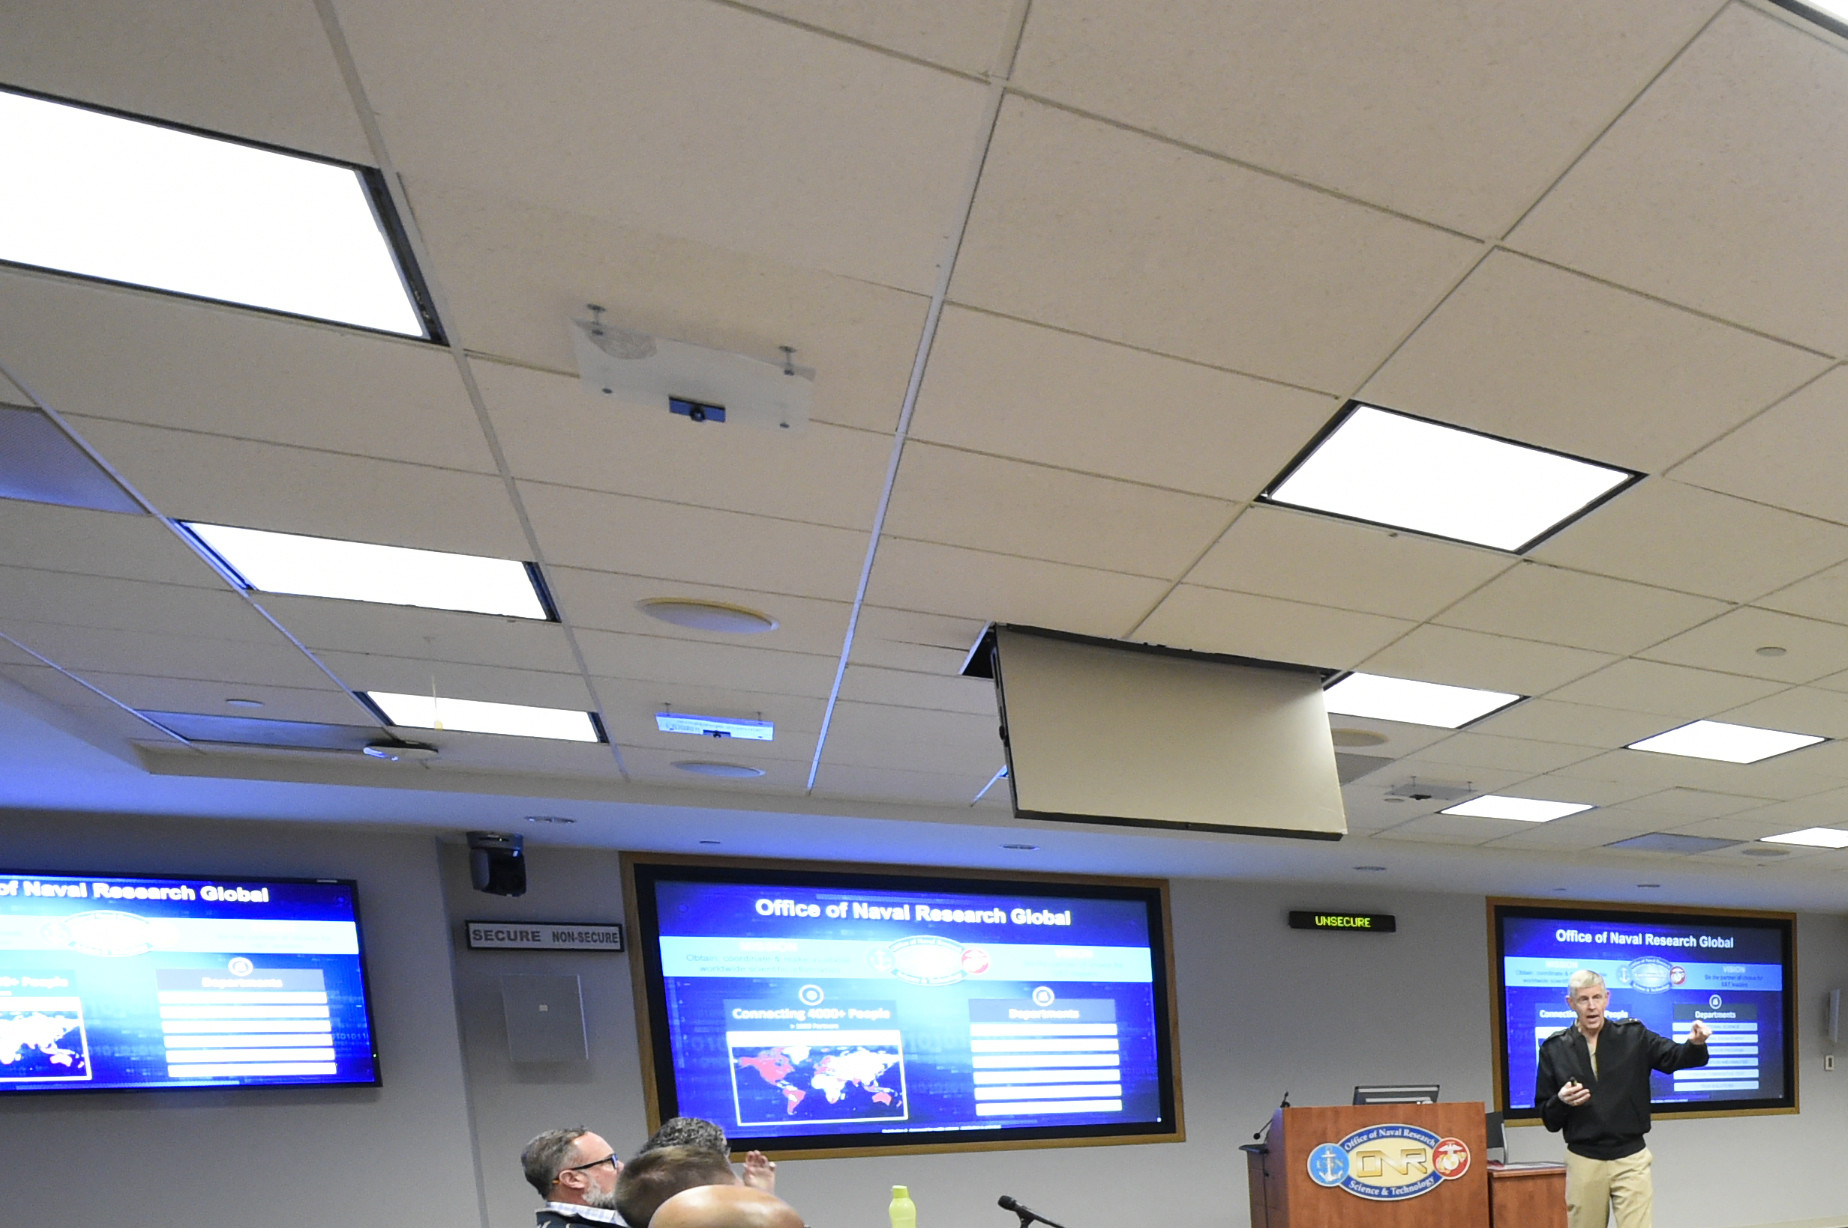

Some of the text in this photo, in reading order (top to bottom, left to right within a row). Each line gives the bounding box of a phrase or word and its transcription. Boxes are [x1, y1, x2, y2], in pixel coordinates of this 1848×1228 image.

[23, 881, 88, 898] Naval
[93, 883, 195, 901] Research
[200, 886, 269, 903] Global
[755, 899, 1071, 926] Office of Naval Research Global
[1315, 916, 1371, 928] UNSECURE
[472, 929, 618, 944] SECURE NON-SECURE
[1555, 929, 1733, 948] Office of Naval Research Global
[732, 1008, 806, 1021] Connecting
[849, 1008, 891, 1021] People
[1009, 1009, 1080, 1021] Departments
[1695, 1011, 1736, 1019] Departments
[1344, 1128, 1436, 1151] Office of Naval Research
[1356, 1148, 1428, 1178] ONR
[1348, 1176, 1434, 1196] Science & Technology
